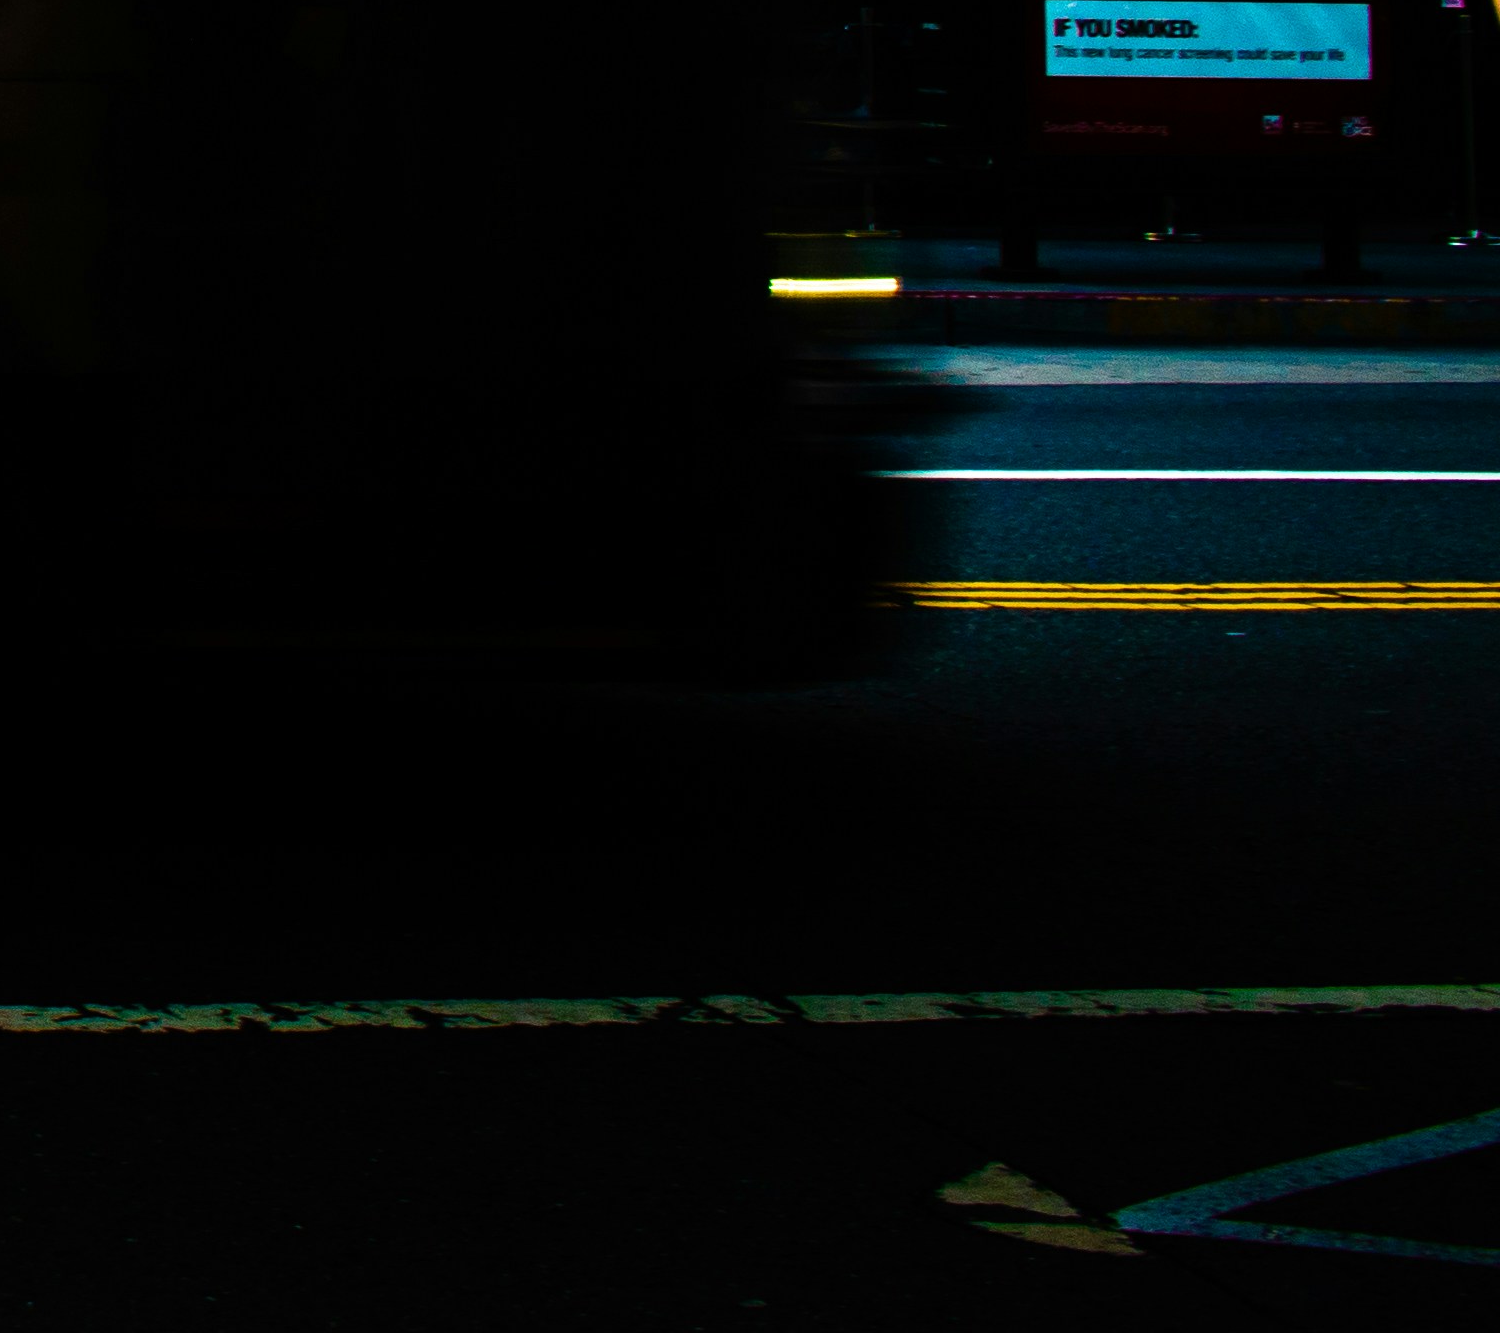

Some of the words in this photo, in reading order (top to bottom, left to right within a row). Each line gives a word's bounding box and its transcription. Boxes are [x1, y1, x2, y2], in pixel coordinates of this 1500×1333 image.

[1053, 19, 1071, 37] IF
[1075, 19, 1111, 37] YOU
[1115, 19, 1199, 38] SMOKED:
